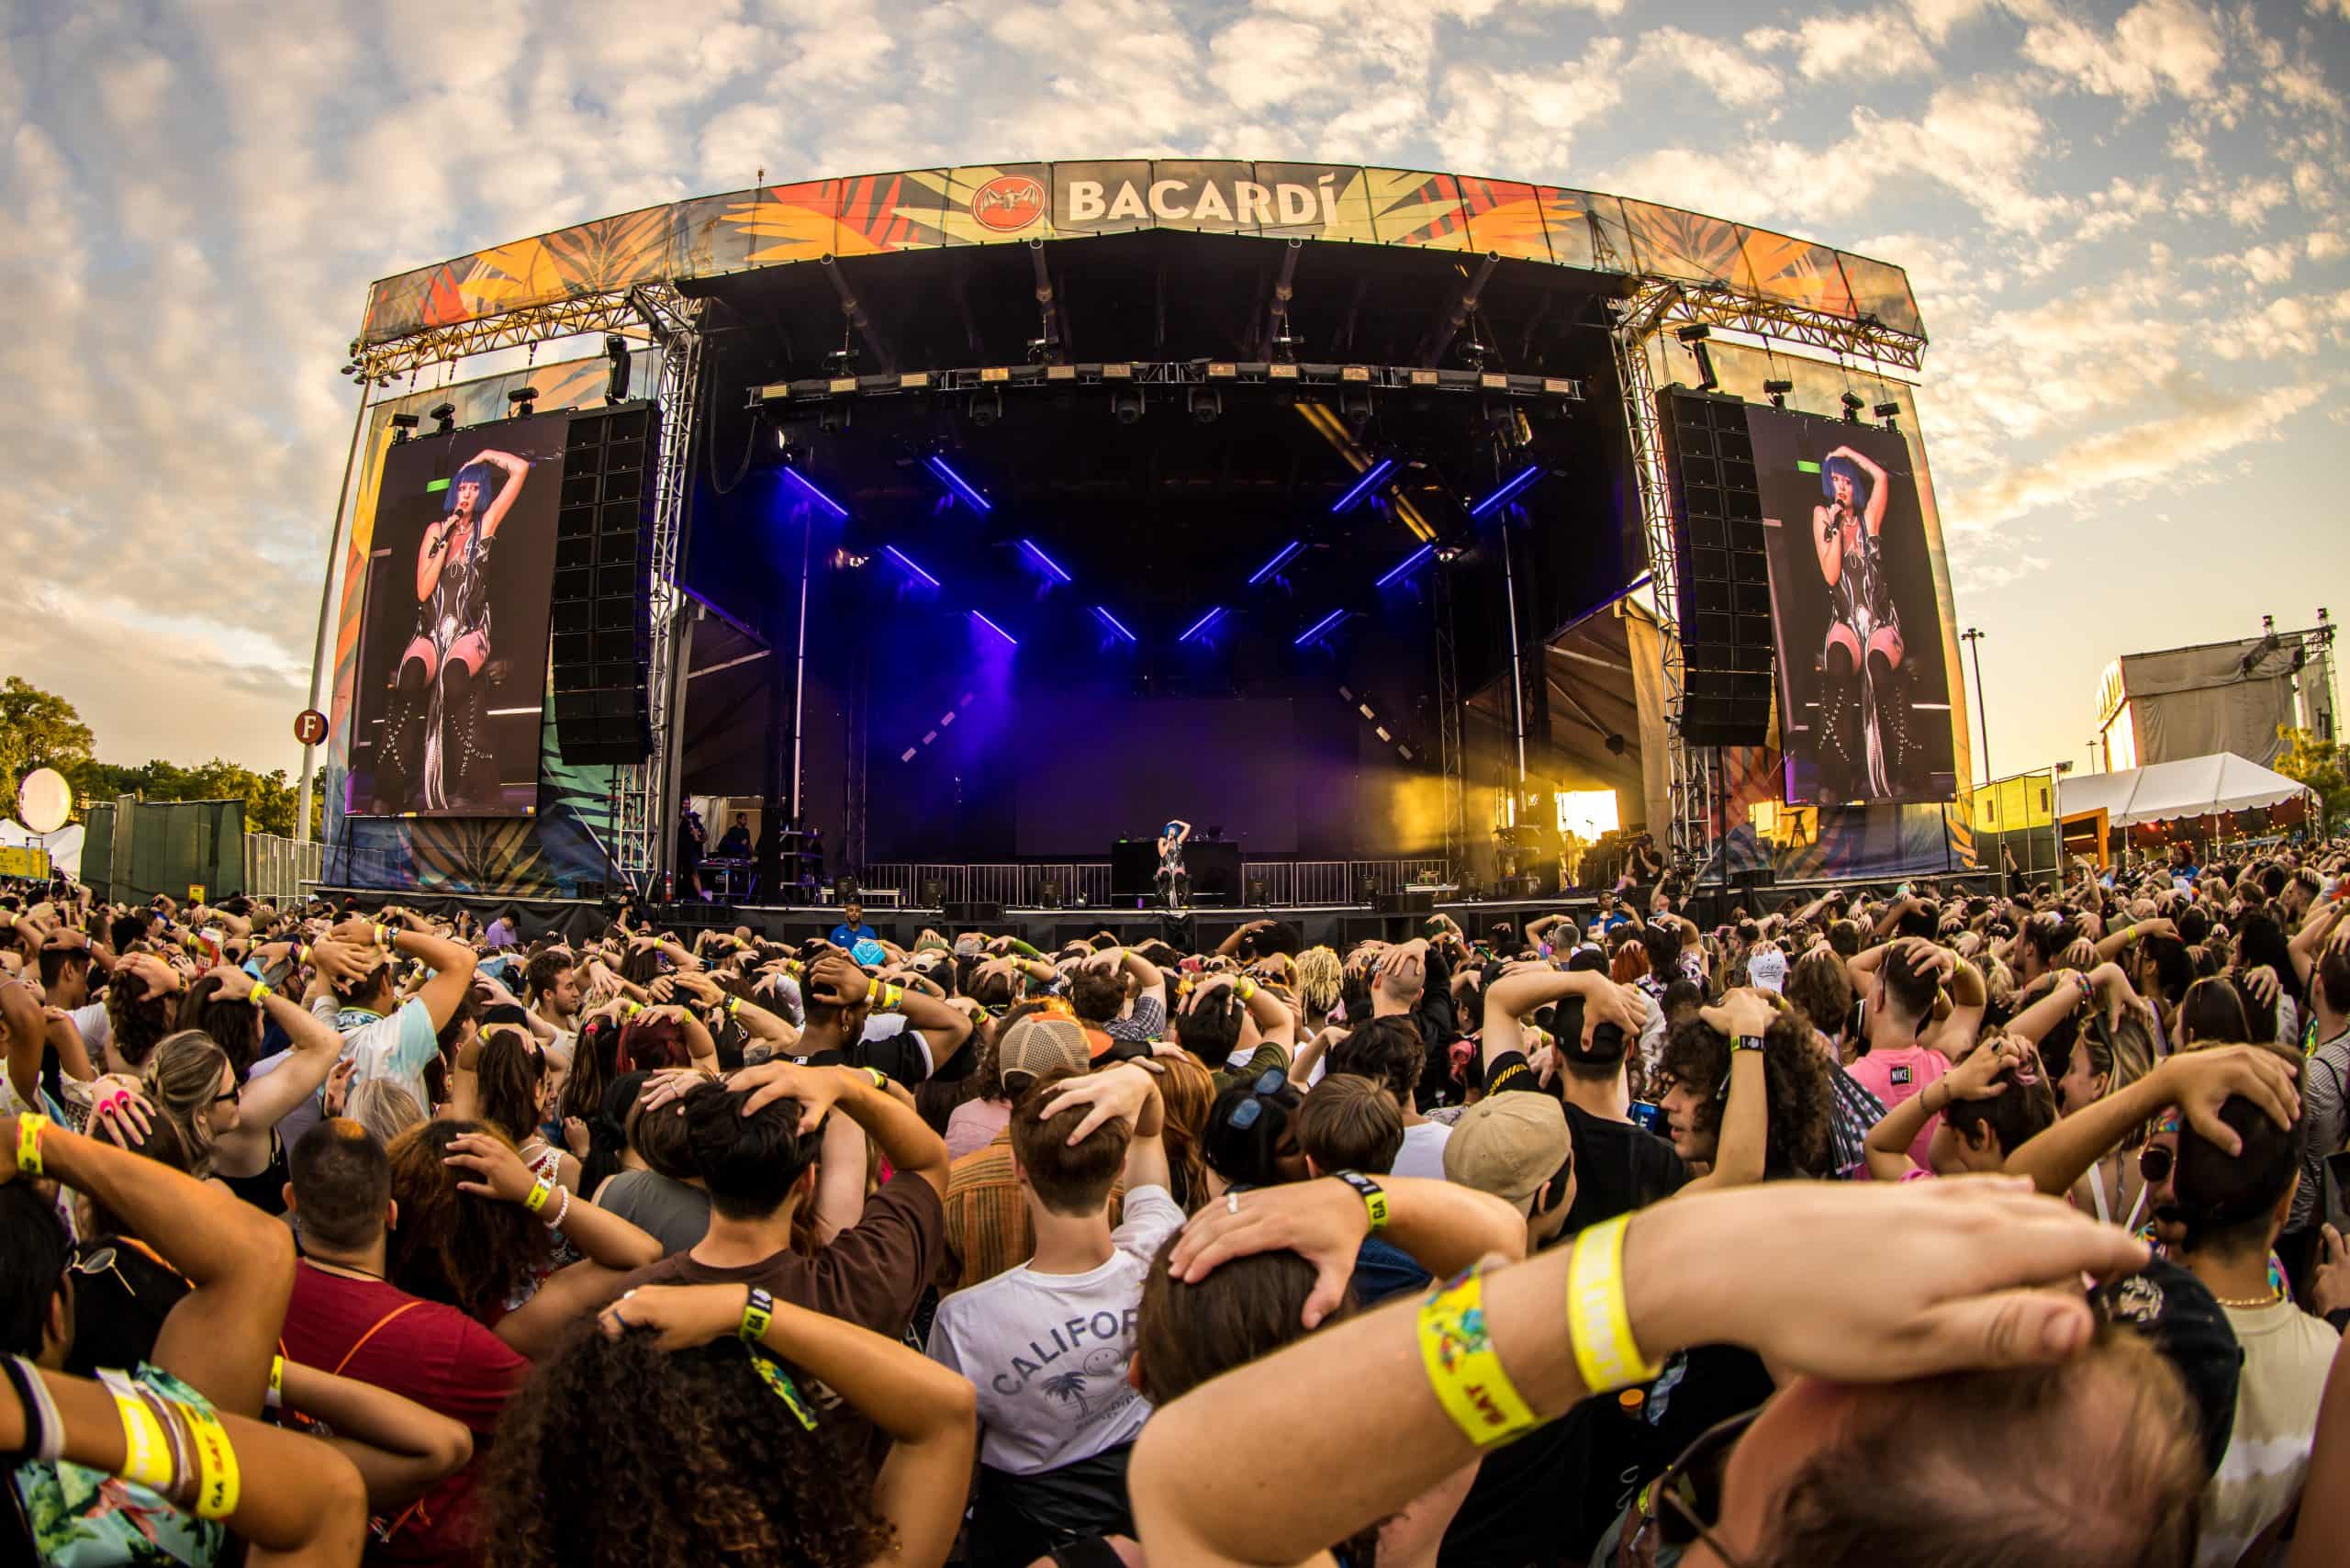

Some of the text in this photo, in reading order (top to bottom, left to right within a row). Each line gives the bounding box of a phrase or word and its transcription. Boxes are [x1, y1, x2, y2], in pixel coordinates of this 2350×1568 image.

[1069, 173, 1337, 227] BACARDÍ
[302, 715, 317, 738] F
[1892, 1068, 1908, 1081] NIKE
